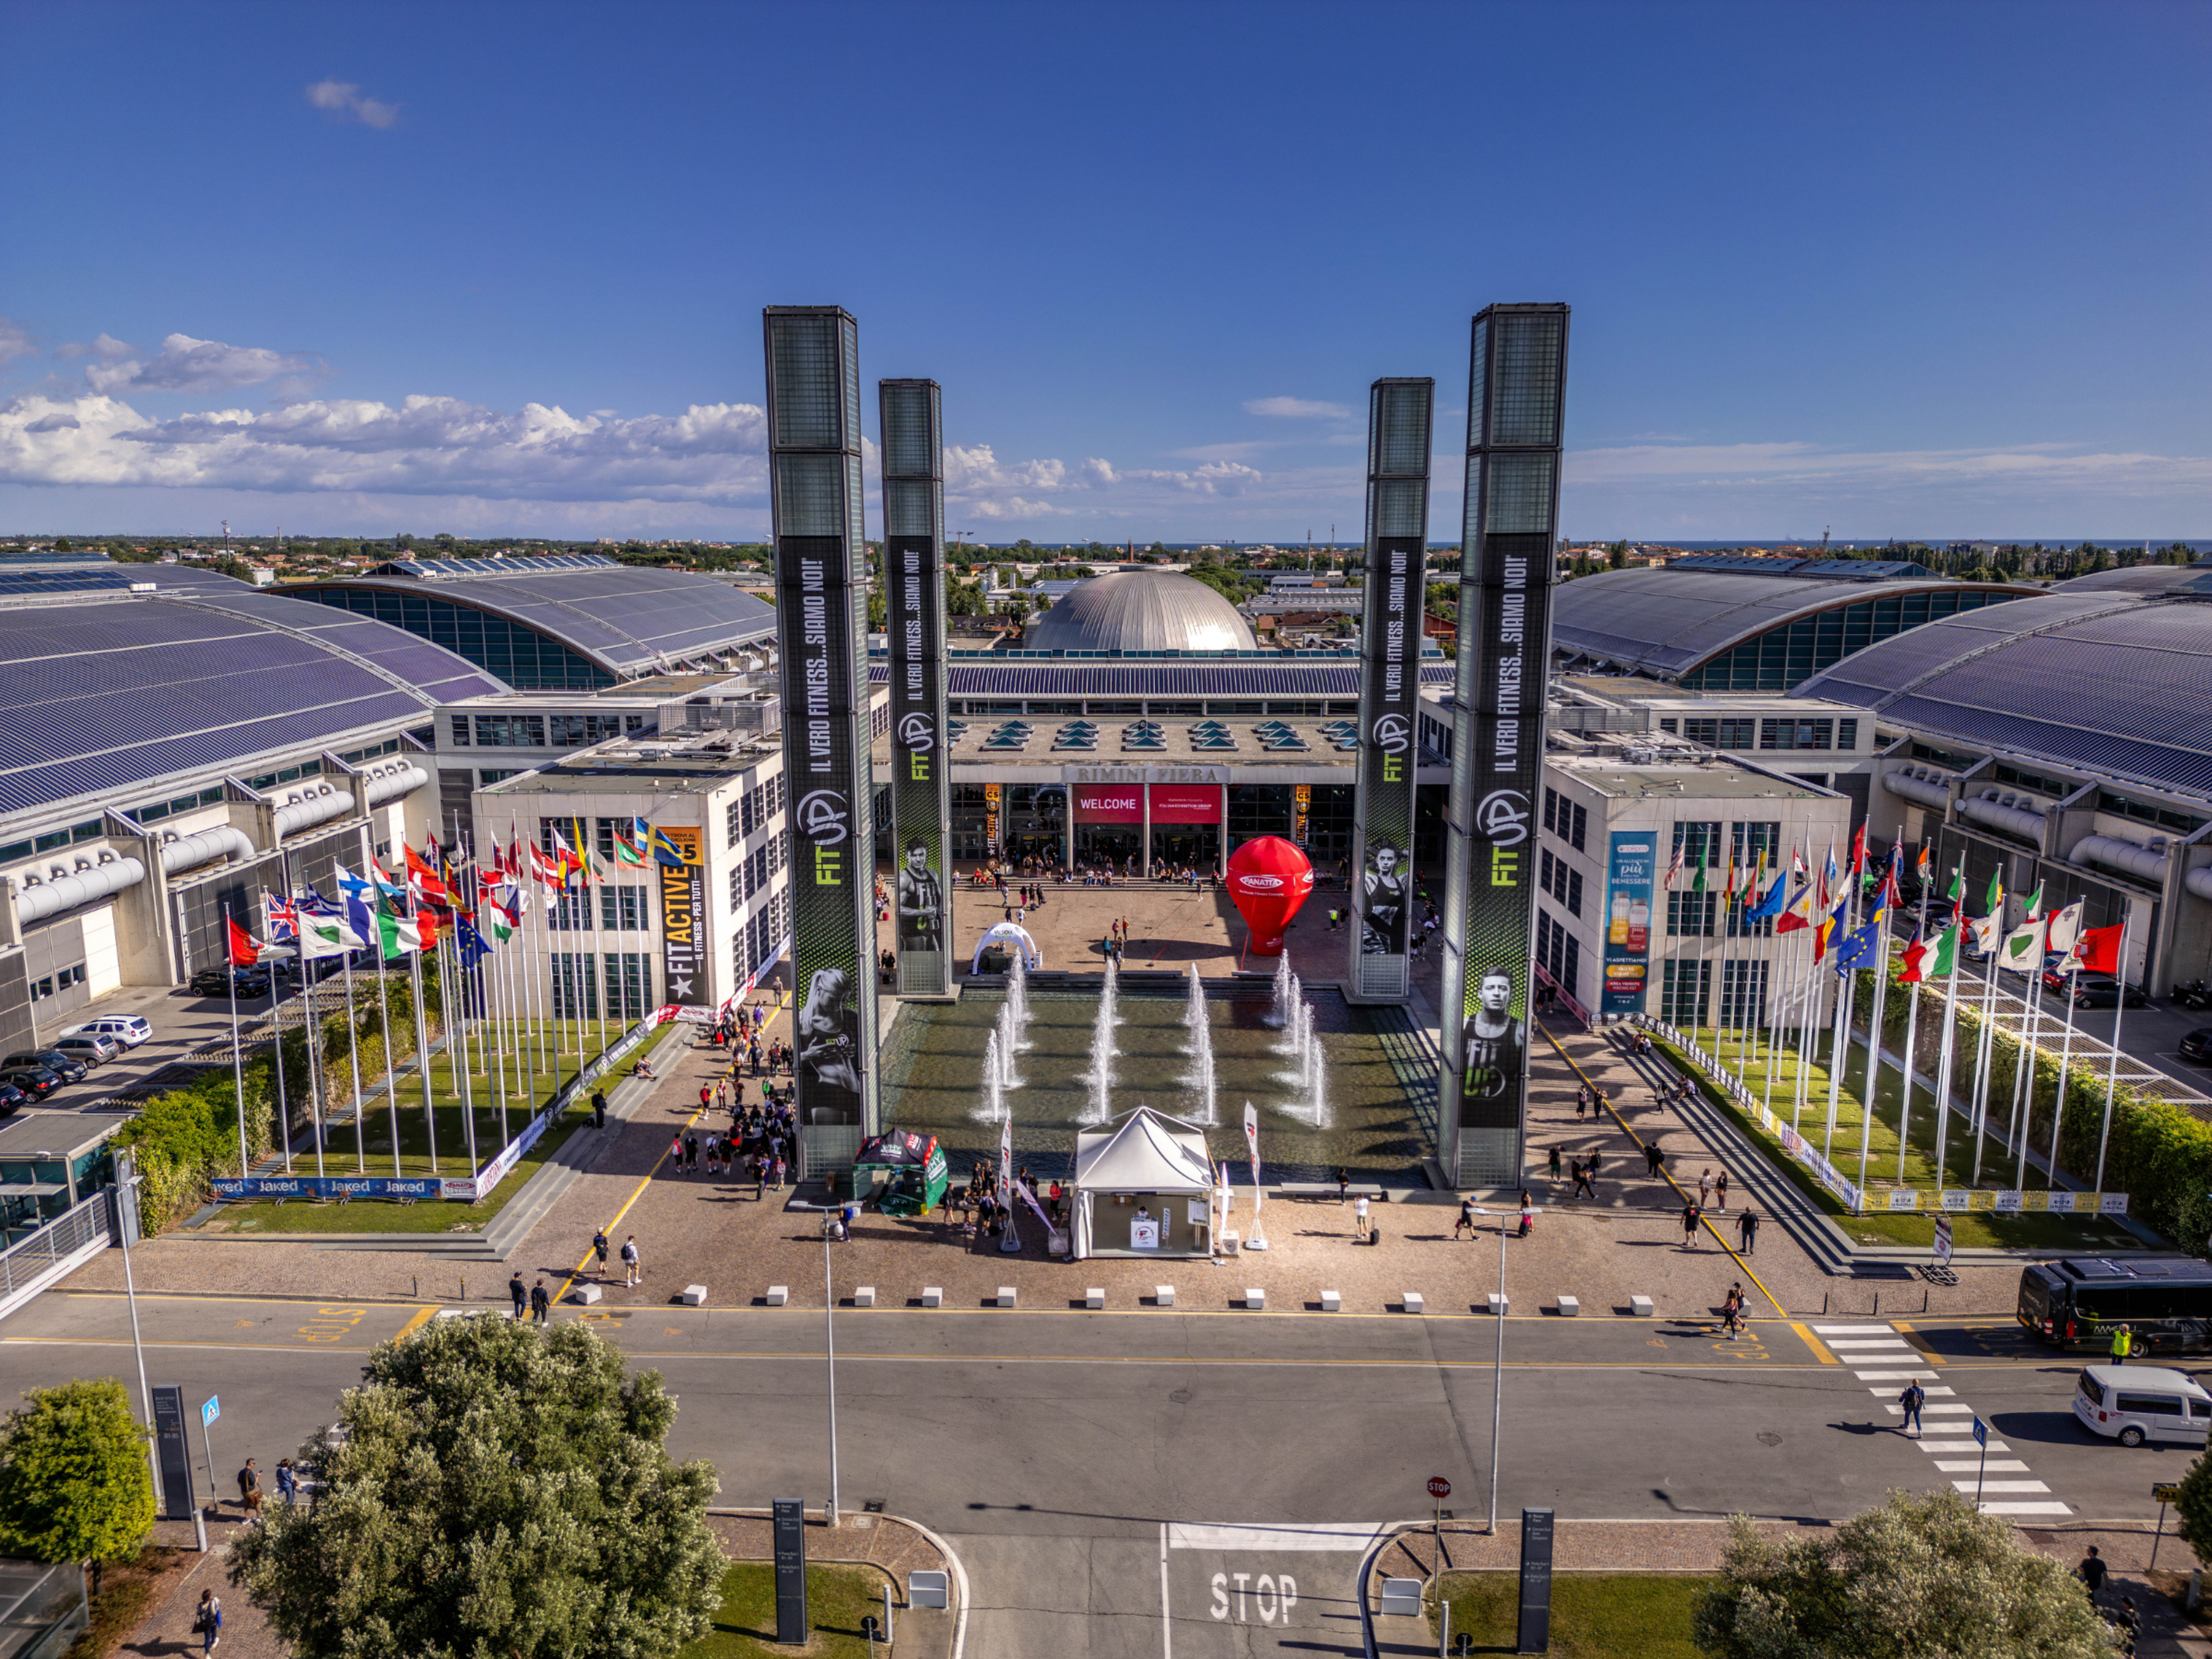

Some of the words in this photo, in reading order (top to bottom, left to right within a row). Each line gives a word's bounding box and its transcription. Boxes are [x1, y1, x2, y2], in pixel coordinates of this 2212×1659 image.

[907, 664, 922, 689] VERO
[1386, 665, 1402, 690] VERO
[908, 691, 923, 700] IL
[1385, 692, 1401, 701] IL
[808, 720, 831, 756] VERO
[1496, 719, 1519, 756] VERO
[810, 760, 831, 772] IL
[1495, 760, 1516, 771] IL
[1078, 768, 1148, 782] RIMINI
[1157, 768, 1218, 782] FIERA
[1081, 799, 1136, 809] WELCOME
[1621, 861, 1644, 877] più
[1244, 877, 1278, 887] PANATTA
[691, 880, 701, 900] TUTTI
[693, 902, 701, 916] PER
[663, 866, 693, 973] FITACTIVE
[693, 922, 703, 951] FITNESS
[213, 1181, 243, 1192] aked
[260, 1180, 298, 1192] Jaked
[332, 1180, 370, 1191] Jaked
[387, 1181, 425, 1193] Jaked
[292, 1308, 367, 1342] STOP
[1429, 1482, 1449, 1493] STOP
[1210, 1572, 1297, 1625] STOP
